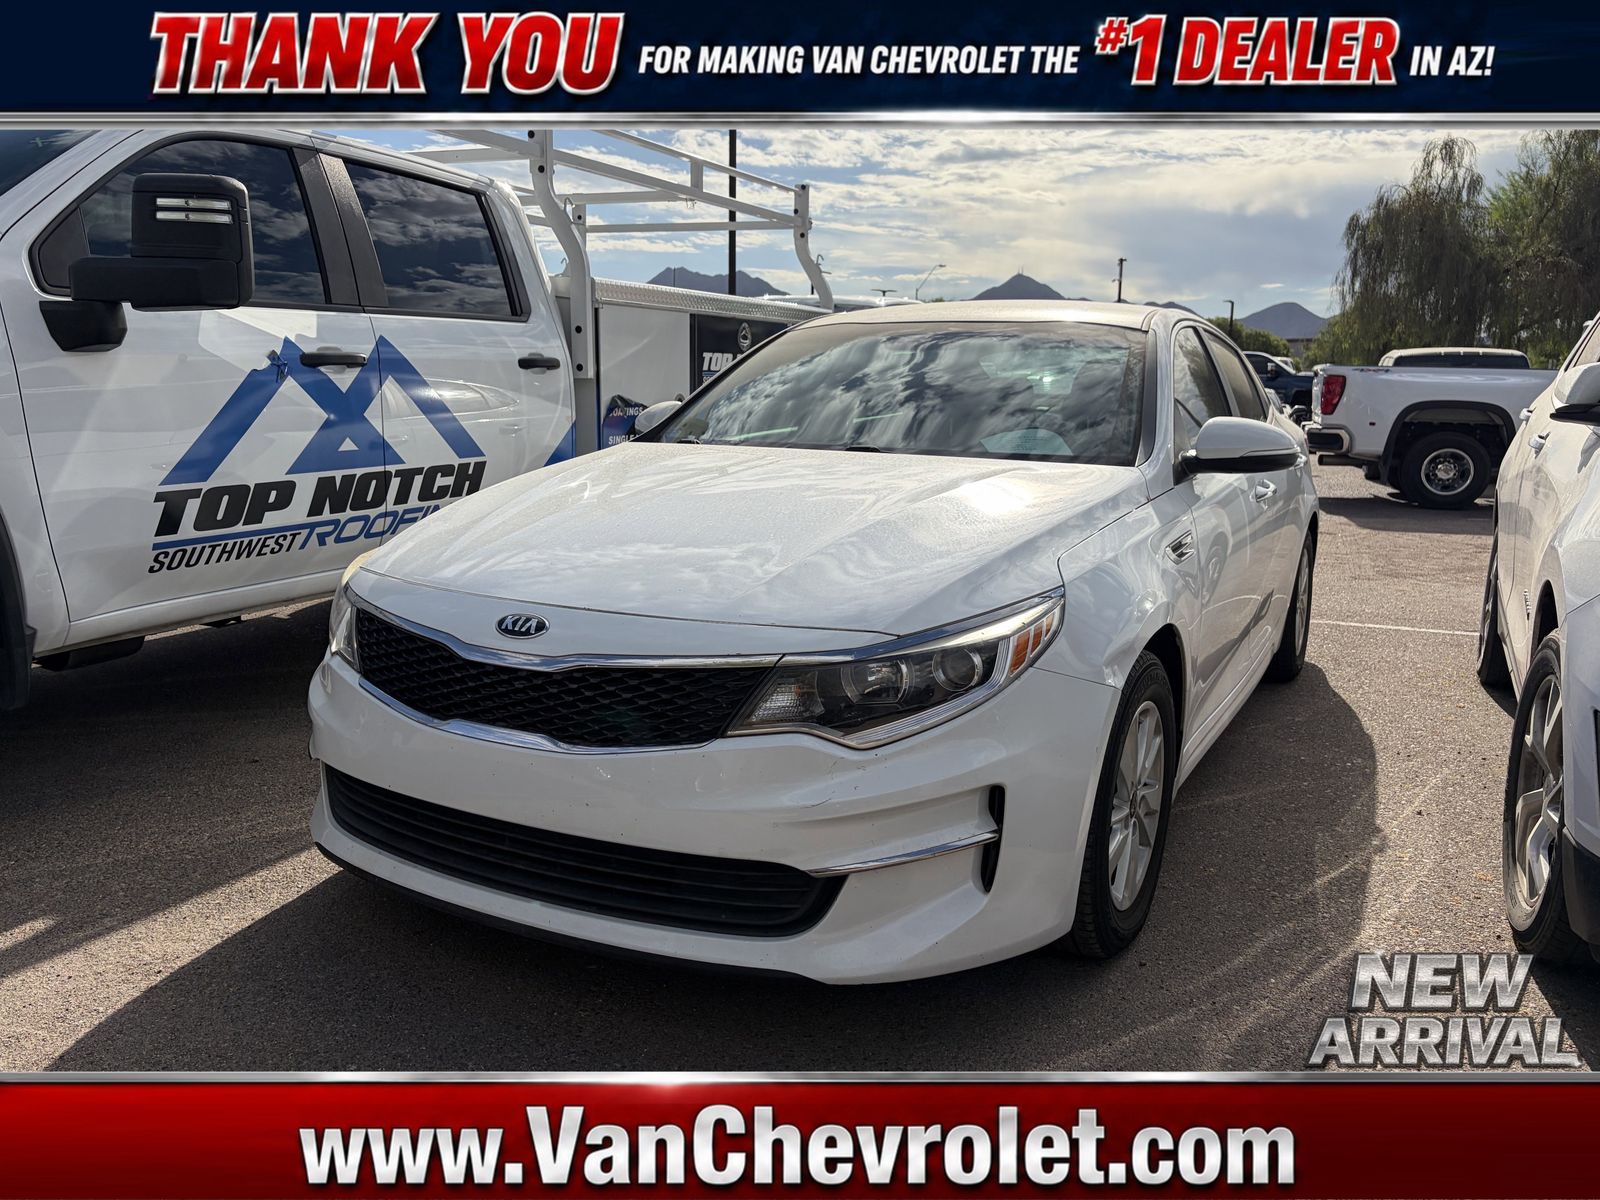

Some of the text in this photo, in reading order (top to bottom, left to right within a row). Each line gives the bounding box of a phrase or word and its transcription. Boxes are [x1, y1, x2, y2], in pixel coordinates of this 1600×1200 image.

[153, 461, 487, 537] TOP NOTCH
[148, 532, 302, 574] SOUTHWEST
[501, 615, 538, 634] KIA
